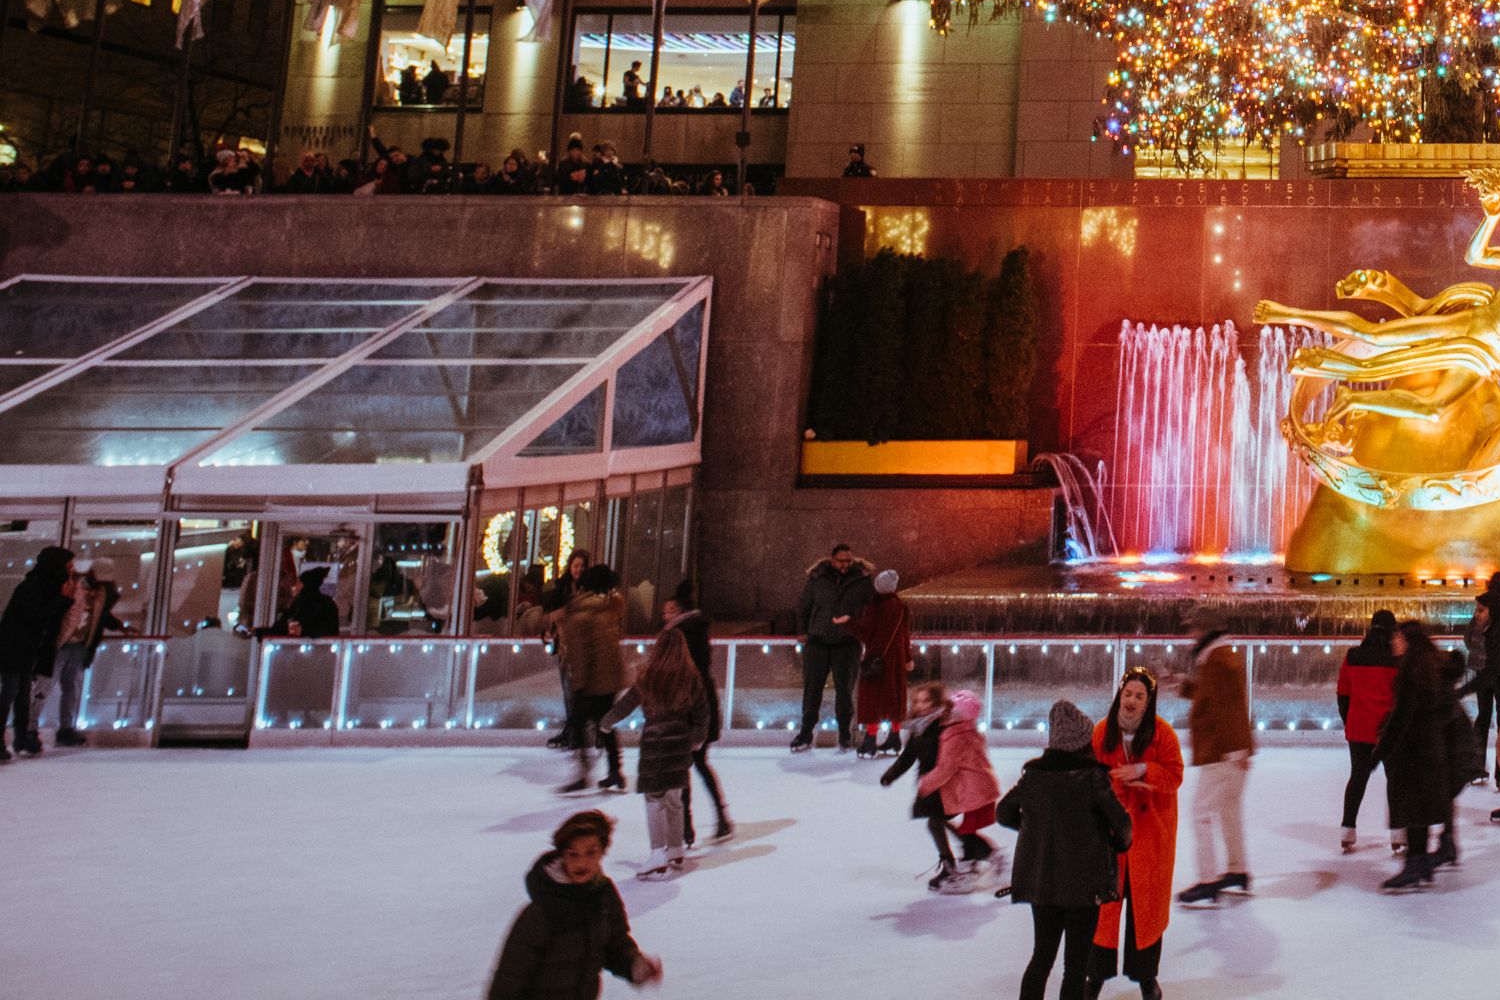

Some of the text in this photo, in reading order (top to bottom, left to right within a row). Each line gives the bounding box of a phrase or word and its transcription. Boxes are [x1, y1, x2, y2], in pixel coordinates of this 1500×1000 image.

[1177, 183, 1314, 192] TEACHER
[1353, 184, 1381, 193] IN
[1132, 195, 1248, 205] PROVED
[1286, 196, 1315, 205] TO
[1350, 196, 1470, 206] MORTAL
